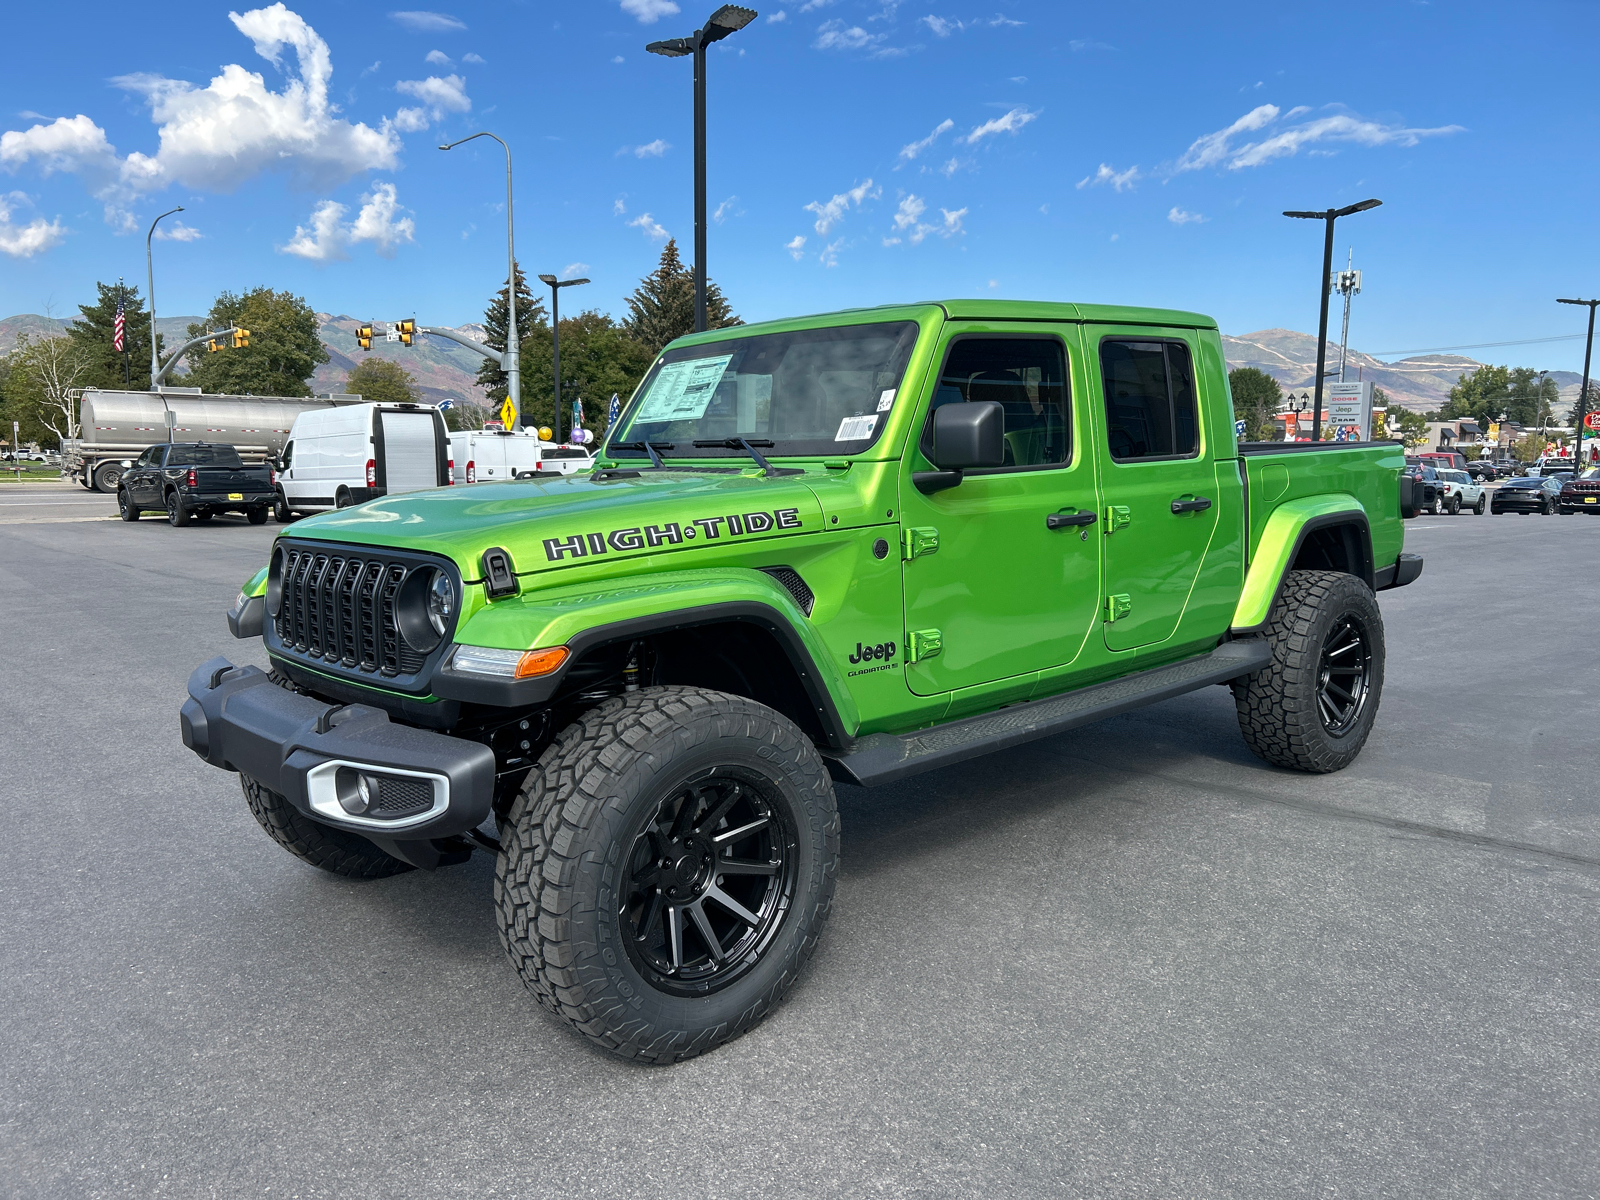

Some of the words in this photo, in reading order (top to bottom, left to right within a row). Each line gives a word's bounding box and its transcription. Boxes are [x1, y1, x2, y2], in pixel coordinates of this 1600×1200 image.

[542, 522, 683, 561] HIGH
[693, 508, 802, 539] TIDE
[848, 664, 891, 677] GLADIATOR
[849, 641, 896, 664] Jeep
[757, 746, 804, 786] OPEN
[598, 840, 620, 942] TIRES
[601, 946, 645, 1011] TOYO
